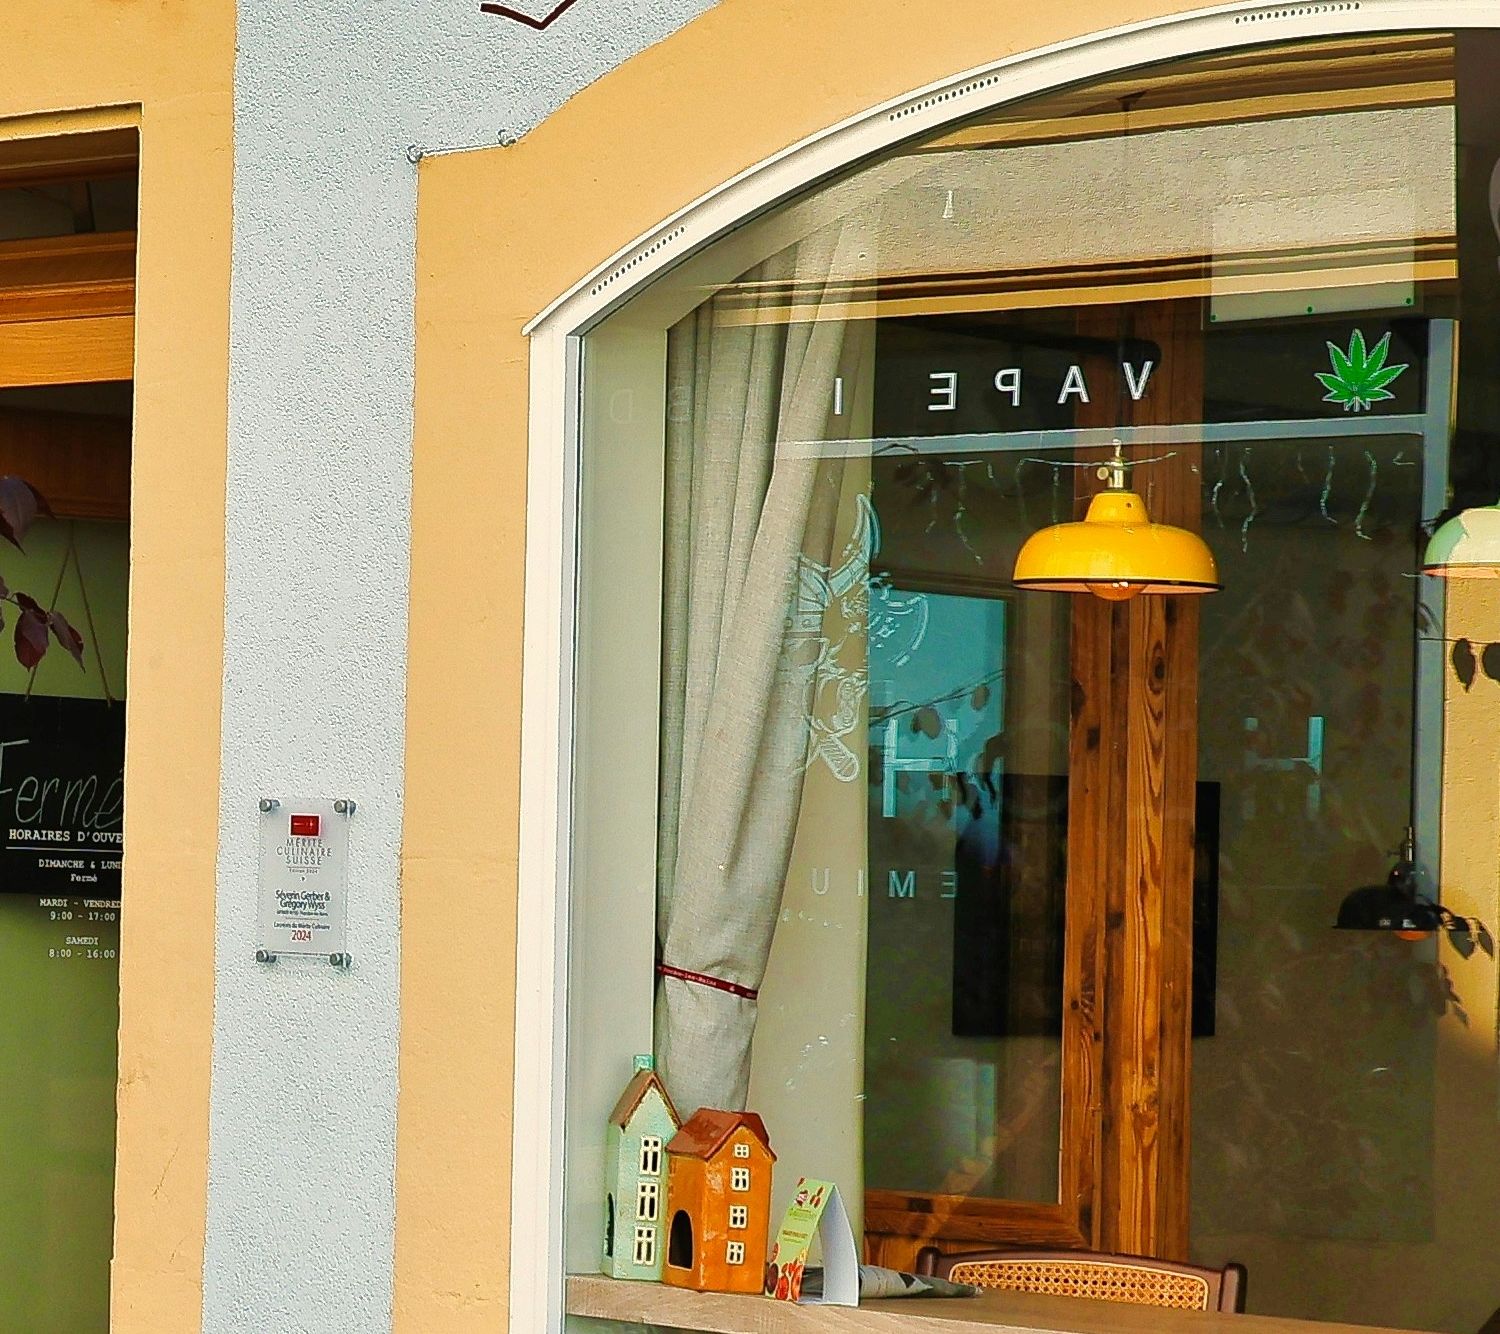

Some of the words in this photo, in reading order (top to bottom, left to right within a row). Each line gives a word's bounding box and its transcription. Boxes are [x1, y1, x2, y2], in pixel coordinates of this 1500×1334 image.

[9, 829, 70, 842] HORAIRES
[276, 846, 332, 857] CULINAIRE
[38, 859, 84, 869] DIMANCHE
[286, 856, 322, 866] SUISSE
[40, 899, 68, 908] MARDI
[50, 911, 73, 921] 9:00
[88, 912, 116, 921] 17:00
[291, 929, 312, 941] 2024
[65, 936, 99, 946] SAMEDI
[48, 948, 72, 958] 8:00
[86, 949, 116, 959] 16:00
